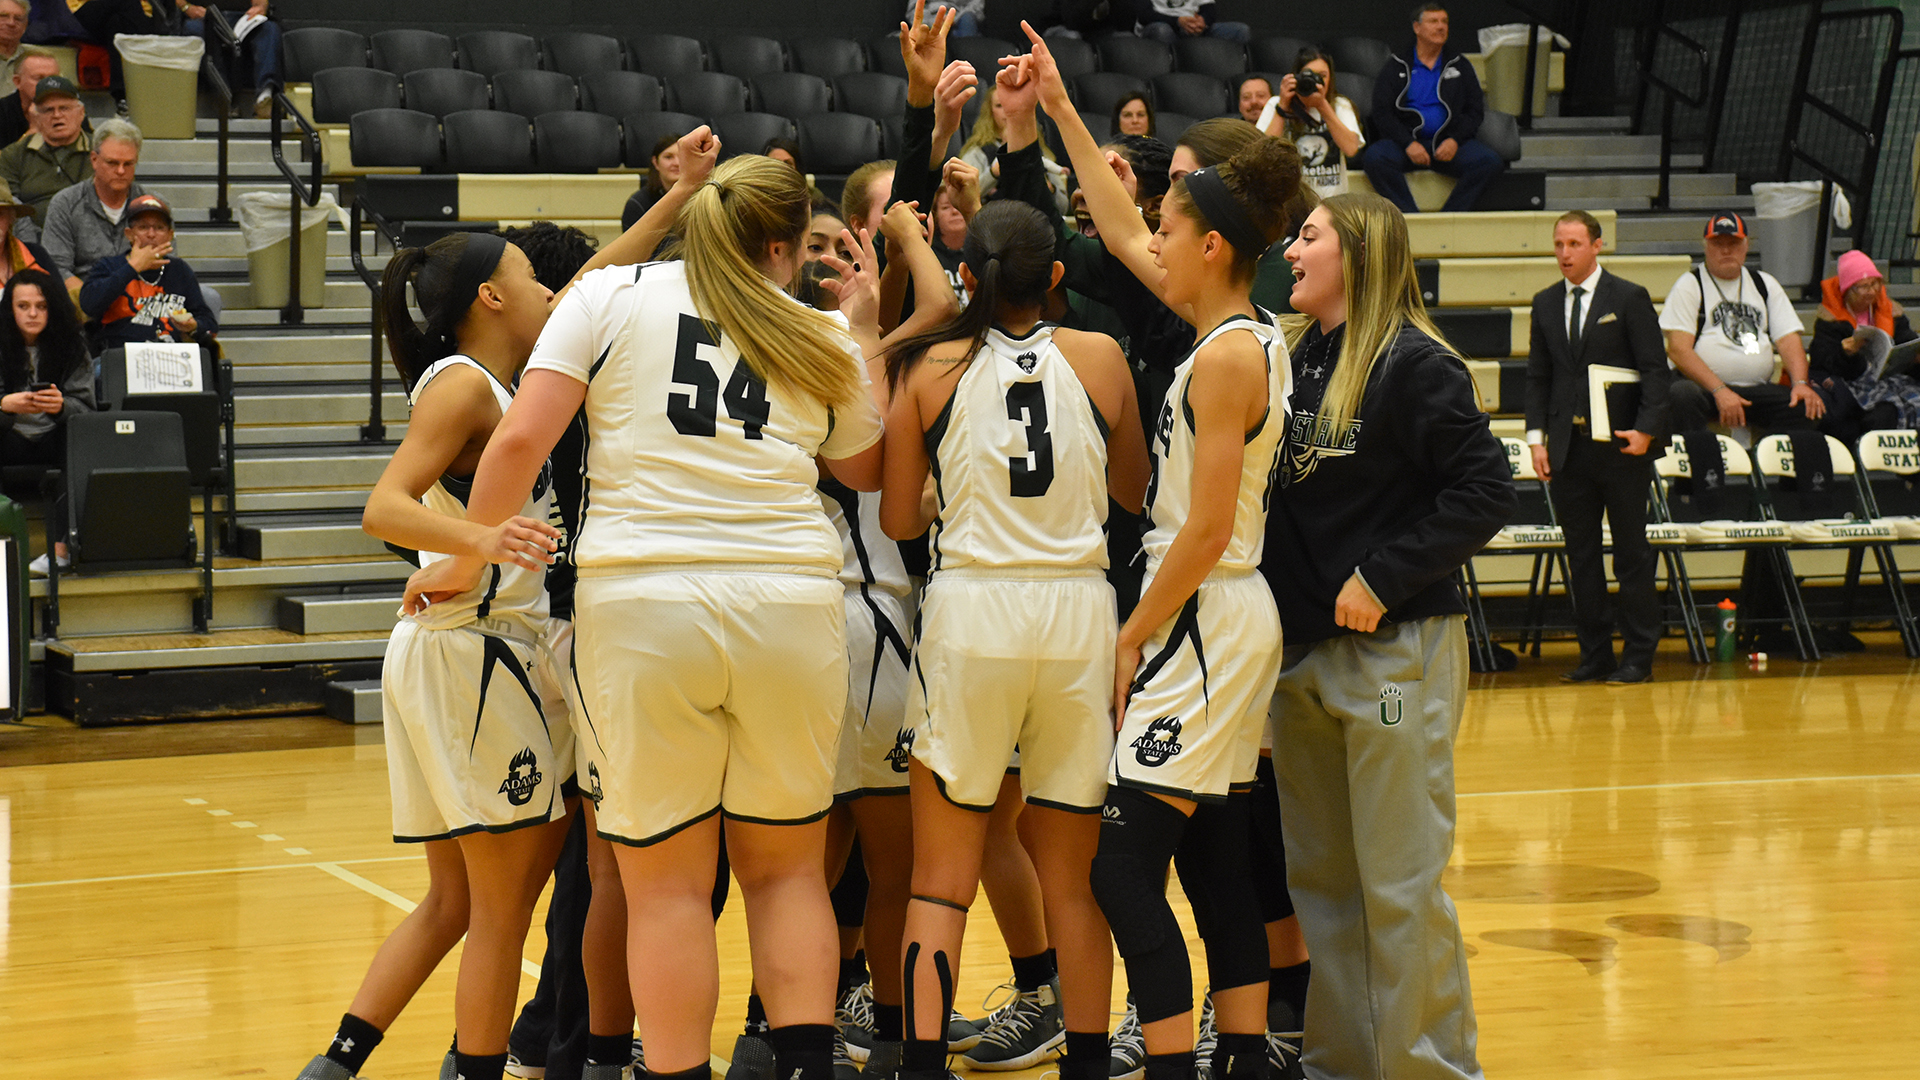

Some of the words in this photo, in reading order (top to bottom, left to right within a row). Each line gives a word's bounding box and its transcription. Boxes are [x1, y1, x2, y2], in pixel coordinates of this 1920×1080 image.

[1302, 164, 1340, 176] ketball
[666, 311, 772, 441] 54
[1004, 379, 1055, 498] 3
[1877, 434, 1918, 449] ADAM
[1882, 452, 1920, 468] STAT
[1513, 532, 1566, 544] GRIZZLIE
[1647, 529, 1680, 539] ZLIES
[1131, 737, 1182, 756] ADAMS
[1141, 748, 1164, 759] STATE
[500, 771, 542, 792] ADAMS
